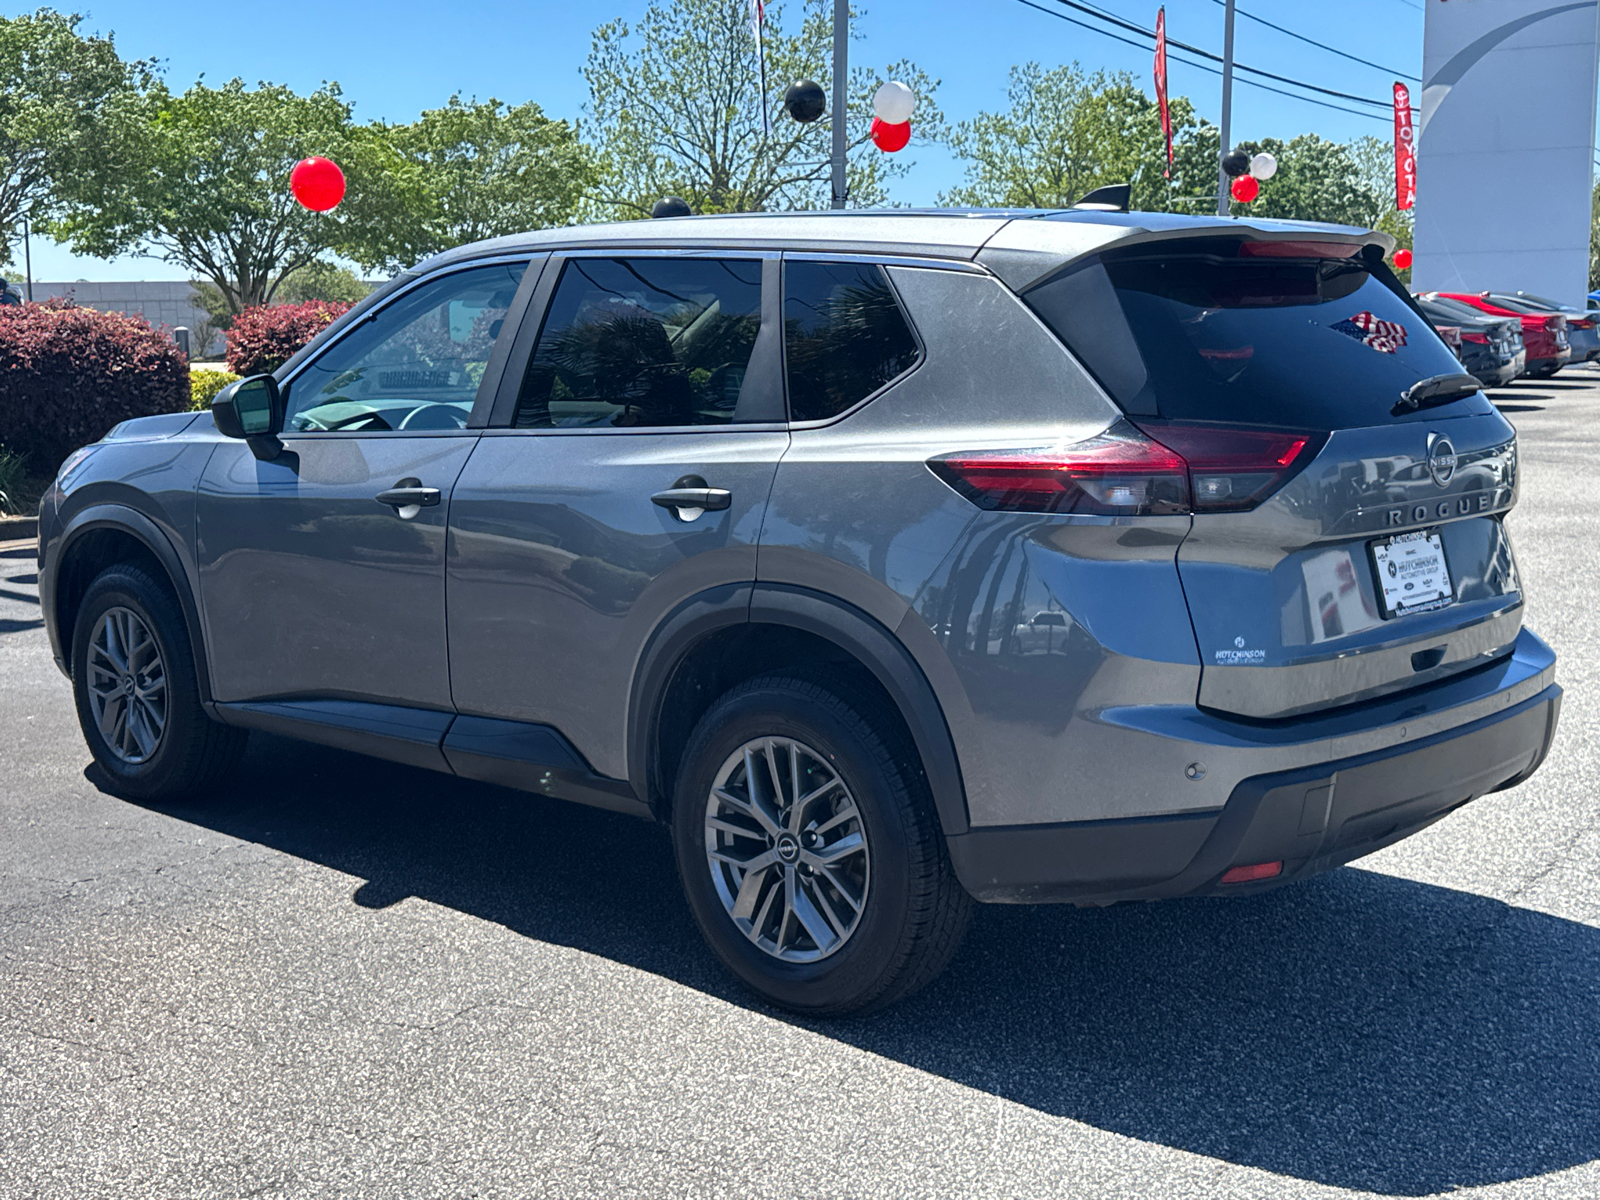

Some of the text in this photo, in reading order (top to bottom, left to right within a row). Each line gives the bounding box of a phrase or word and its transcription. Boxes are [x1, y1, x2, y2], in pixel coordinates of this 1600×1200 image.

[1398, 111, 1415, 205] TOYOTA
[1388, 496, 1489, 525] ROGUE
[1215, 649, 1265, 659] HUTCHINSON
